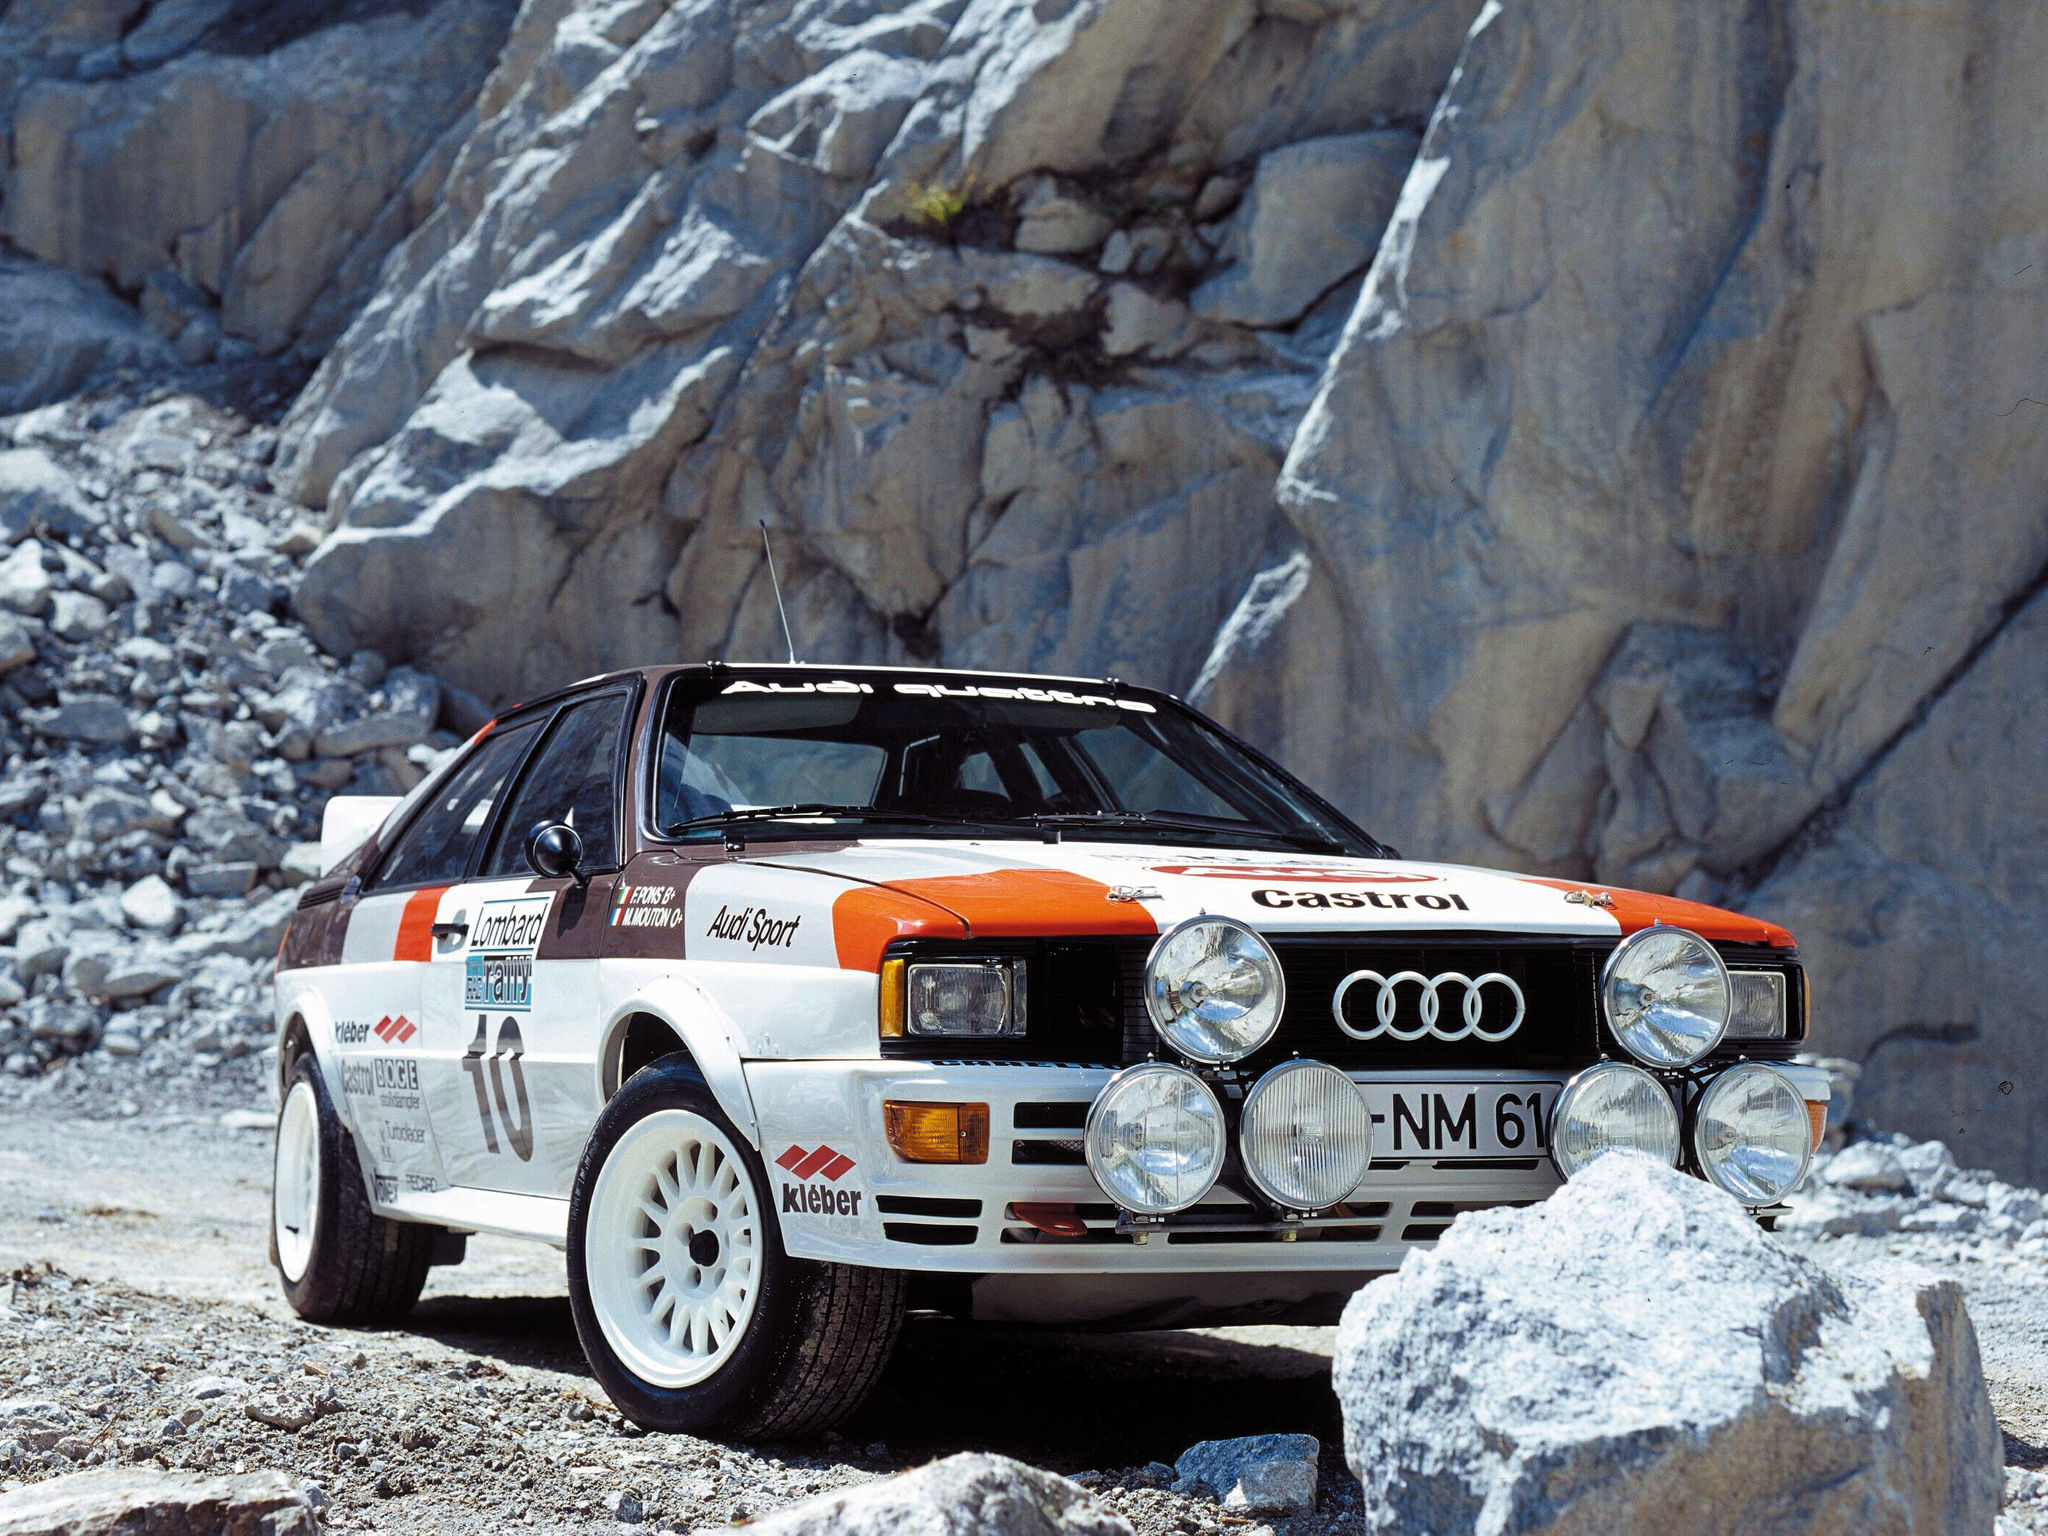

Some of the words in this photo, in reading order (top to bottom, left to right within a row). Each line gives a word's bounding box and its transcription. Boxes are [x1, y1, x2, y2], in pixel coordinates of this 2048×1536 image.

[721, 681, 874, 694] Audi
[893, 683, 1157, 713] quattro
[1251, 889, 1470, 911] Castrol
[471, 903, 548, 947] Lombard
[706, 905, 753, 943] Audi
[747, 908, 801, 951] Sport
[484, 956, 532, 1003] rally
[462, 1014, 533, 1162] 10
[1495, 1092, 1545, 1149] 61
[782, 1183, 862, 1216] kléber
